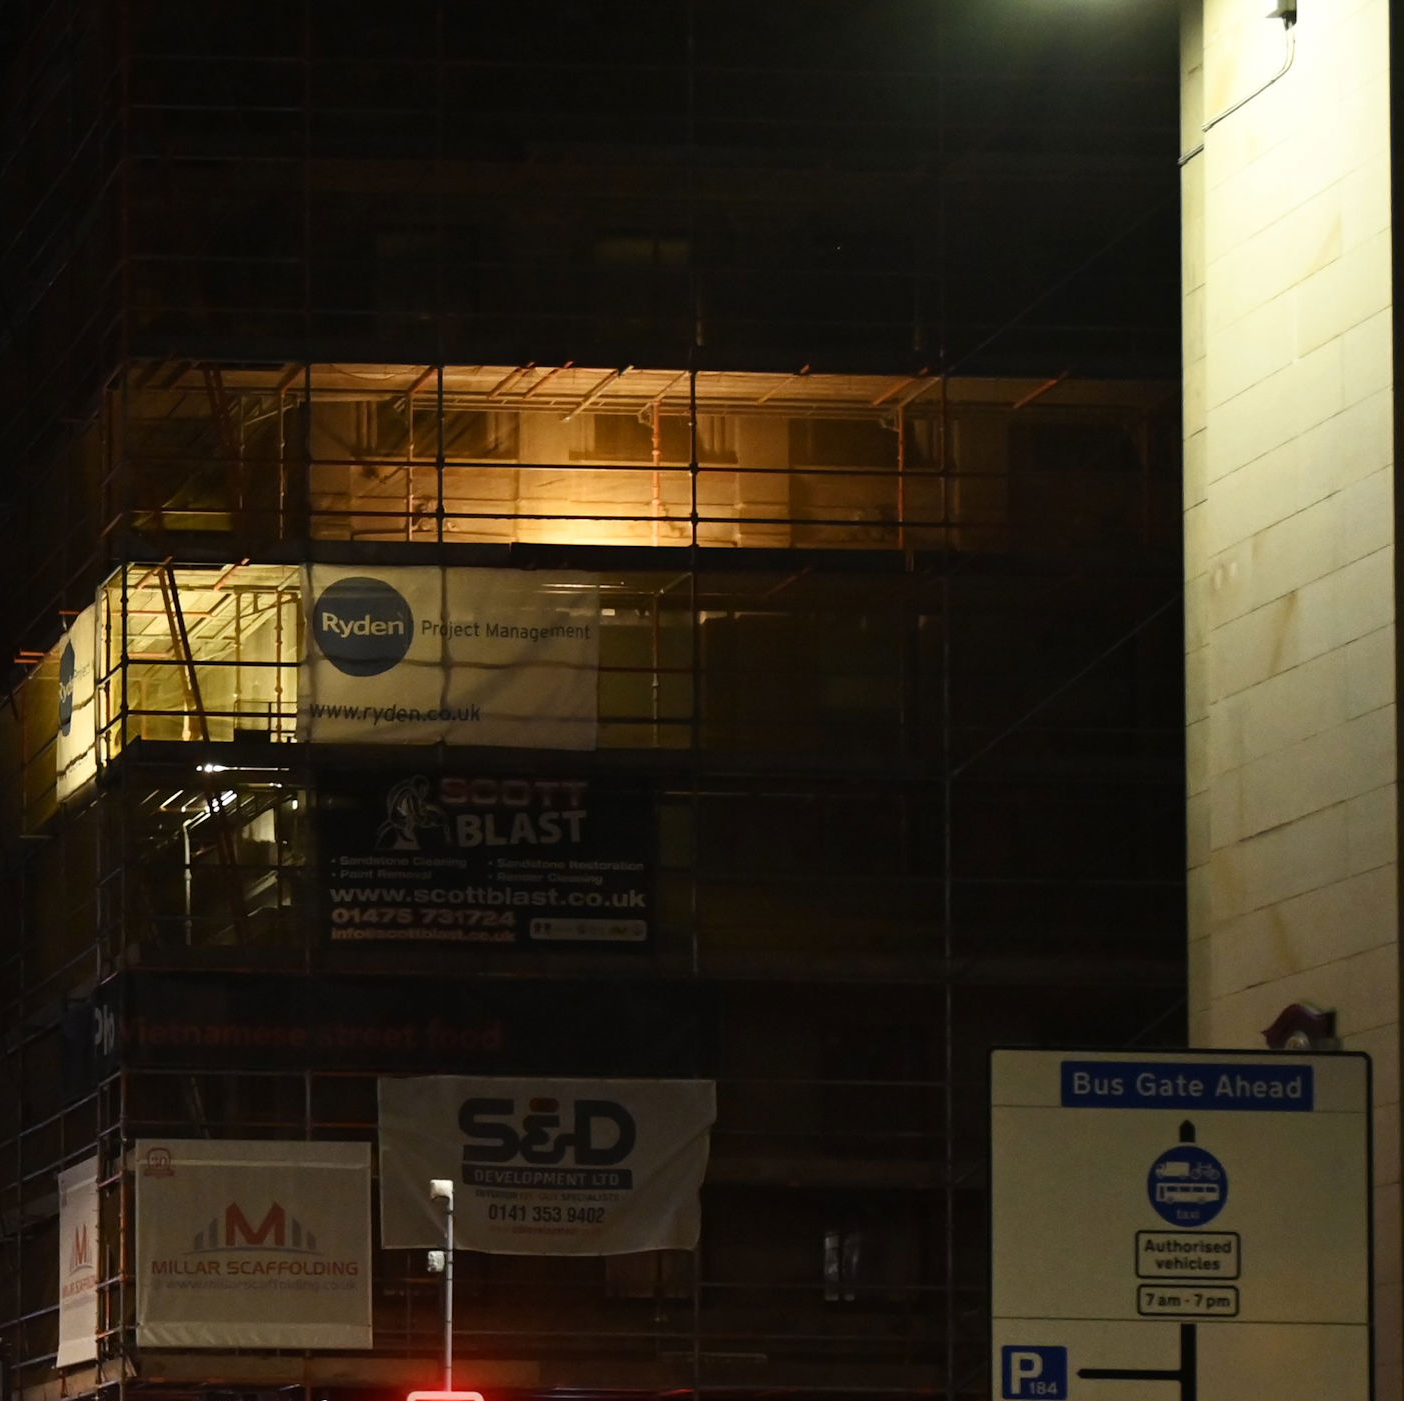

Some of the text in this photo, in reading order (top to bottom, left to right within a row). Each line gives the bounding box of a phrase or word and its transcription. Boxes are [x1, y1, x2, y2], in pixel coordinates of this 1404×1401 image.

[322, 611, 404, 638] Ryden
[421, 620, 592, 642] Project Management
[309, 704, 481, 725] www.ryden.co.uk
[440, 777, 589, 808] SCOTT
[456, 810, 588, 848] BLAST
[339, 855, 410, 866] Sandstone
[339, 870, 375, 879] Paint
[329, 886, 646, 908] www.scottblast.co.uk
[330, 907, 517, 927] 01475 731724
[119, 1016, 306, 1048] Vietnamese
[318, 1019, 416, 1048] street
[1072, 1072, 1302, 1099] Bus Gate Ahead
[458, 1097, 637, 1166] S&D
[473, 1168, 620, 1186] DEVELOPMENT LTD
[488, 1204, 606, 1224] 0141 353 9402
[1144, 1239, 1232, 1254] Authorised
[151, 1261, 359, 1276] MILLAR SCAFFOLDING
[1155, 1256, 1221, 1271] vehicles
[1145, 1293, 1155, 1306] 7
[1158, 1296, 1181, 1307] am
[1194, 1294, 1203, 1307] 7
[1206, 1296, 1231, 1309] pm
[1011, 1352, 1043, 1394] P
[1030, 1381, 1058, 1395] 184
